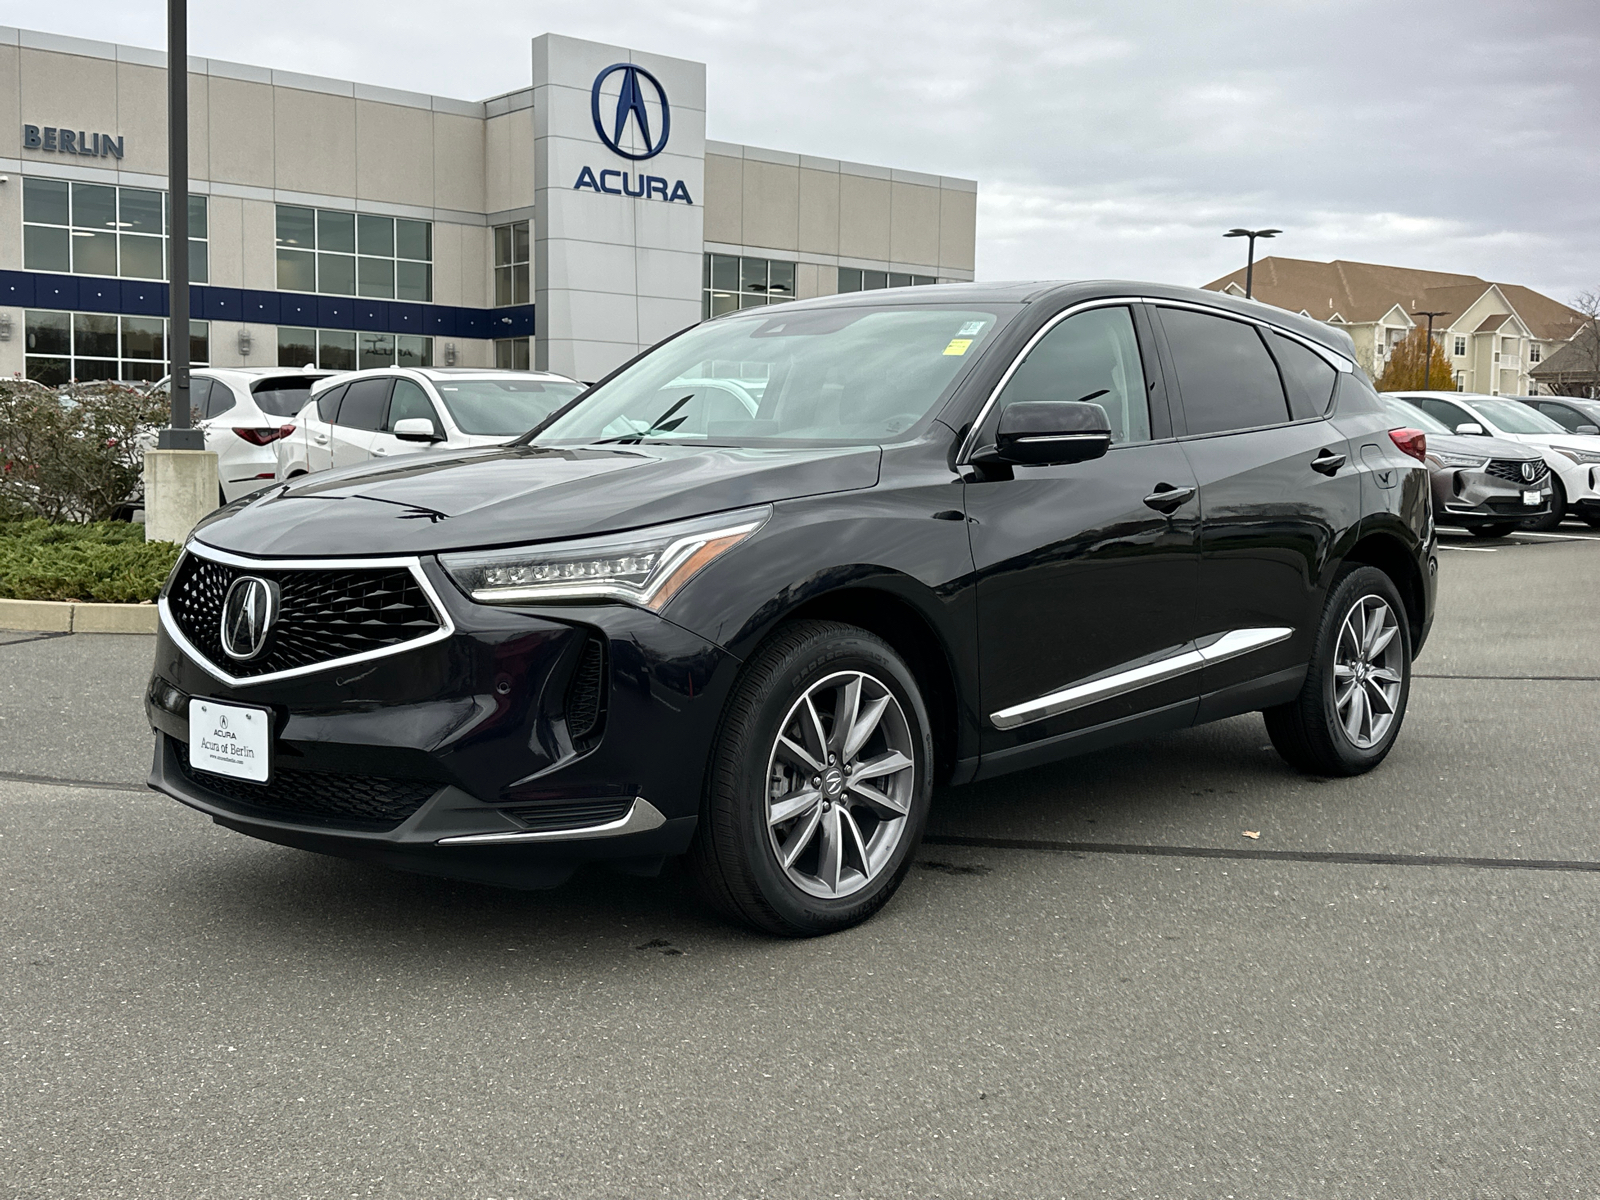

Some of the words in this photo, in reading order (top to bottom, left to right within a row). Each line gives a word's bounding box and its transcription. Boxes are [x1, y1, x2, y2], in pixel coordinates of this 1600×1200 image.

[23, 124, 124, 159] BERLIN
[573, 166, 693, 205] ACURA
[201, 737, 219, 752] Acura
[220, 743, 229, 754] of
[230, 743, 255, 758] Berlin
[213, 729, 237, 740] ACURA
